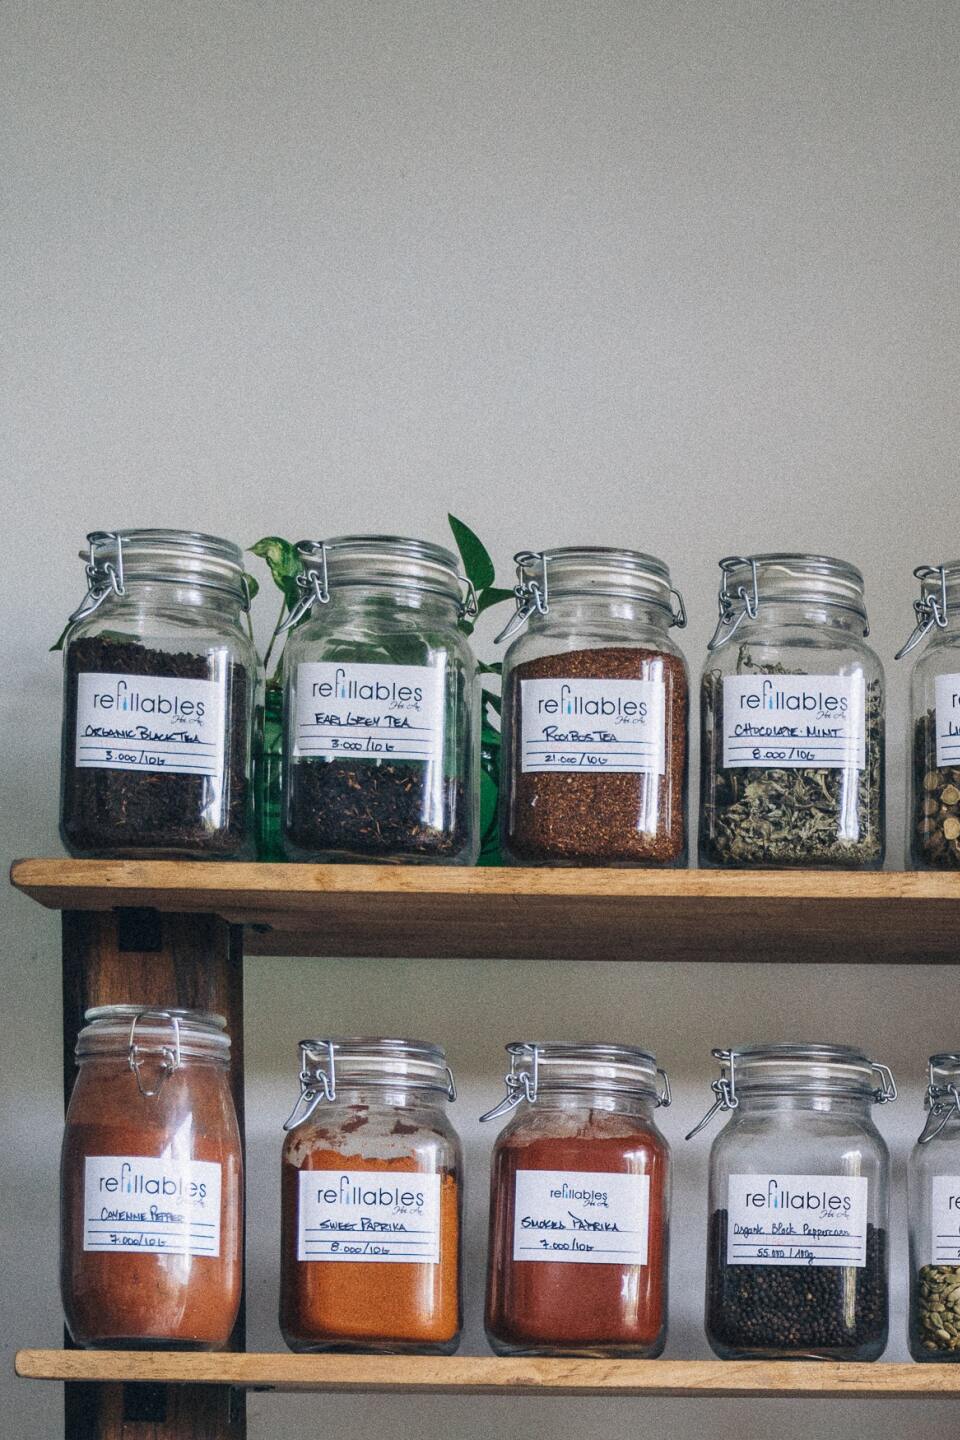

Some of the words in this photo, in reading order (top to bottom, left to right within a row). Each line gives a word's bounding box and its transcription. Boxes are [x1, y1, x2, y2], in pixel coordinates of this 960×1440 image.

[312, 669, 422, 702] refillables
[94, 680, 204, 716] refillables
[539, 685, 647, 716] refillables
[740, 680, 847, 710] refillables
[384, 716, 410, 728] TEA
[85, 724, 135, 738] ORGANIC
[136, 726, 174, 741] BLACK
[593, 731, 619, 742] TEA
[807, 726, 843, 737] MINT
[100, 1163, 206, 1197] refillables
[318, 1176, 424, 1206] refillables
[550, 1183, 608, 1201] refillables
[746, 1180, 851, 1210] refillables
[101, 1207, 147, 1221] CAYENNE
[320, 1220, 357, 1231] SWEET
[360, 1218, 409, 1232] PAPRIKA
[772, 1223, 796, 1235] Black
